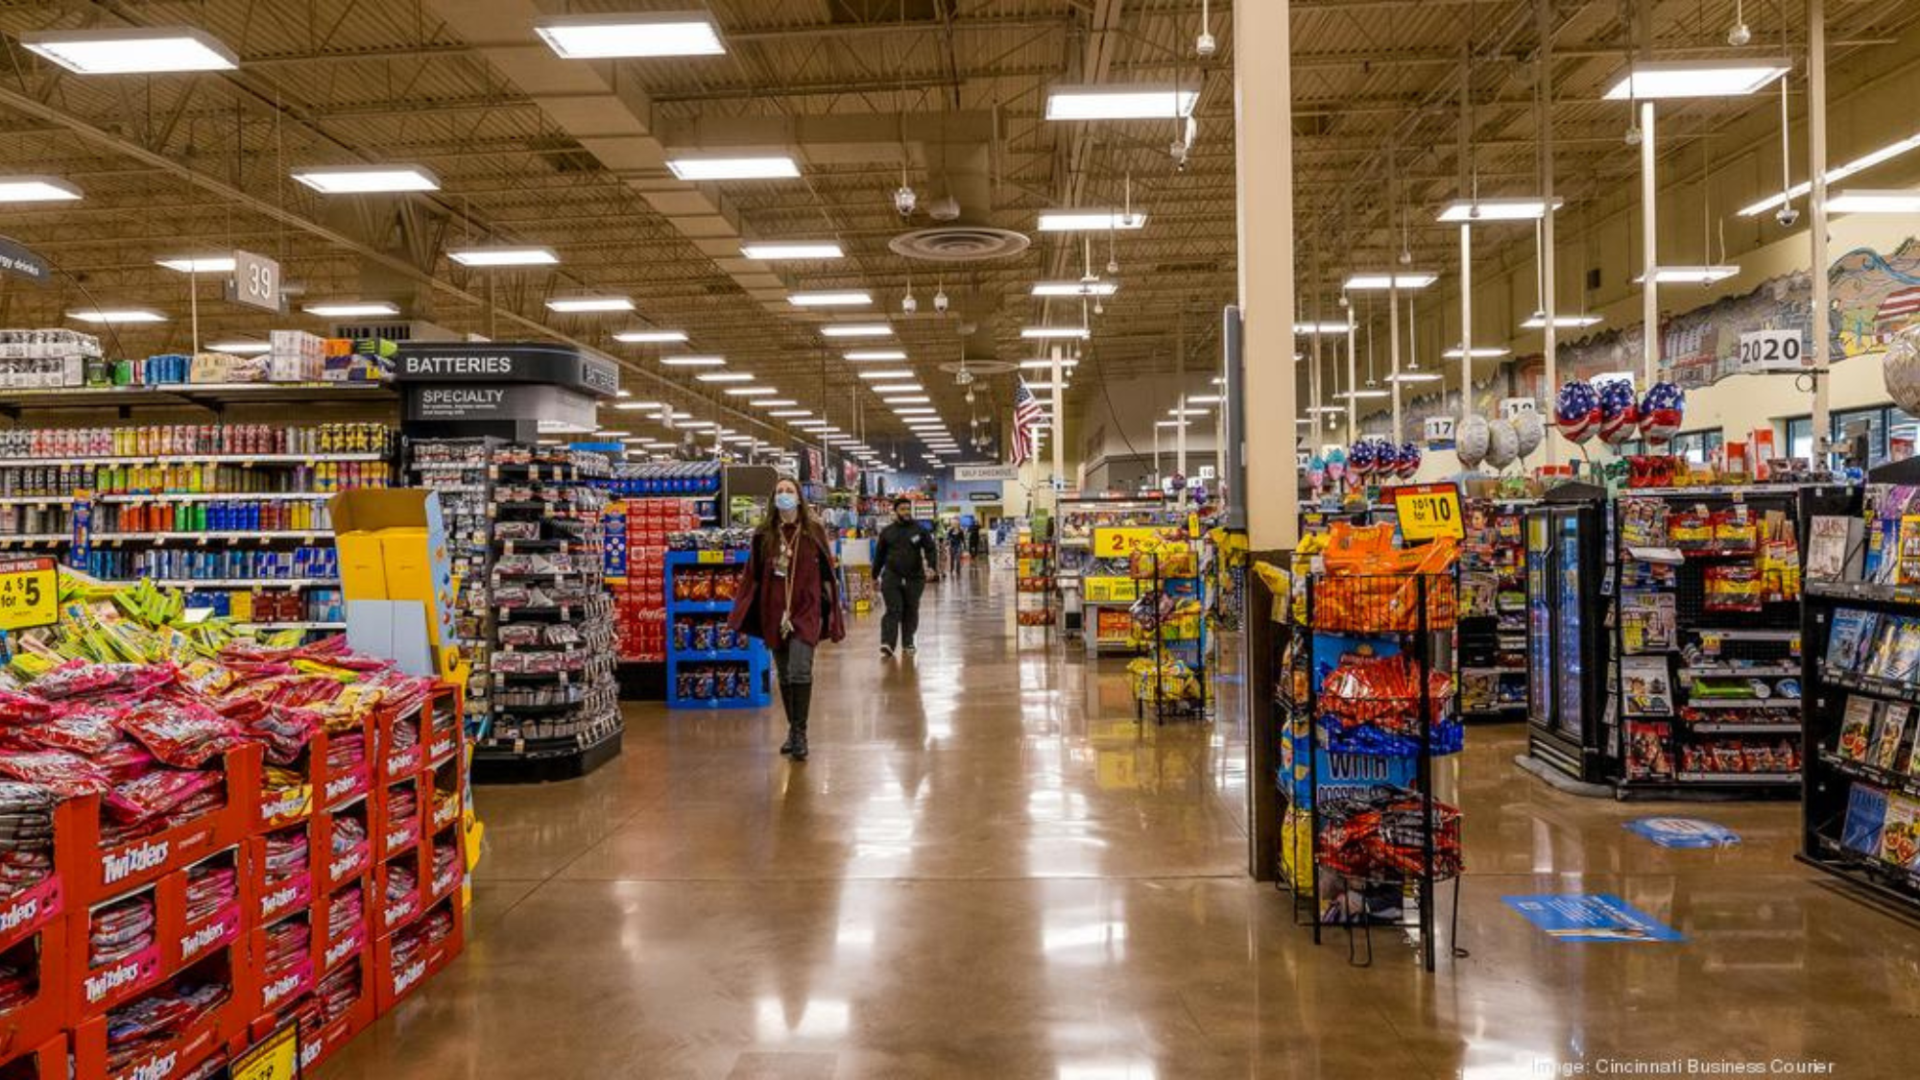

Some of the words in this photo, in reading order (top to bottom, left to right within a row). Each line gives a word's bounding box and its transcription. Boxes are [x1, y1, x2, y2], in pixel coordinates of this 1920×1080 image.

[249, 263, 270, 300] 39
[1742, 339, 1761, 364] 20
[1763, 337, 1800, 361] 20
[406, 357, 512, 374] BATTERIES
[422, 389, 504, 403] SPECIALTY
[1434, 421, 1452, 435] 17
[1112, 534, 1124, 550] 2
[4, 580, 12, 593] 4
[1, 594, 16, 608] for
